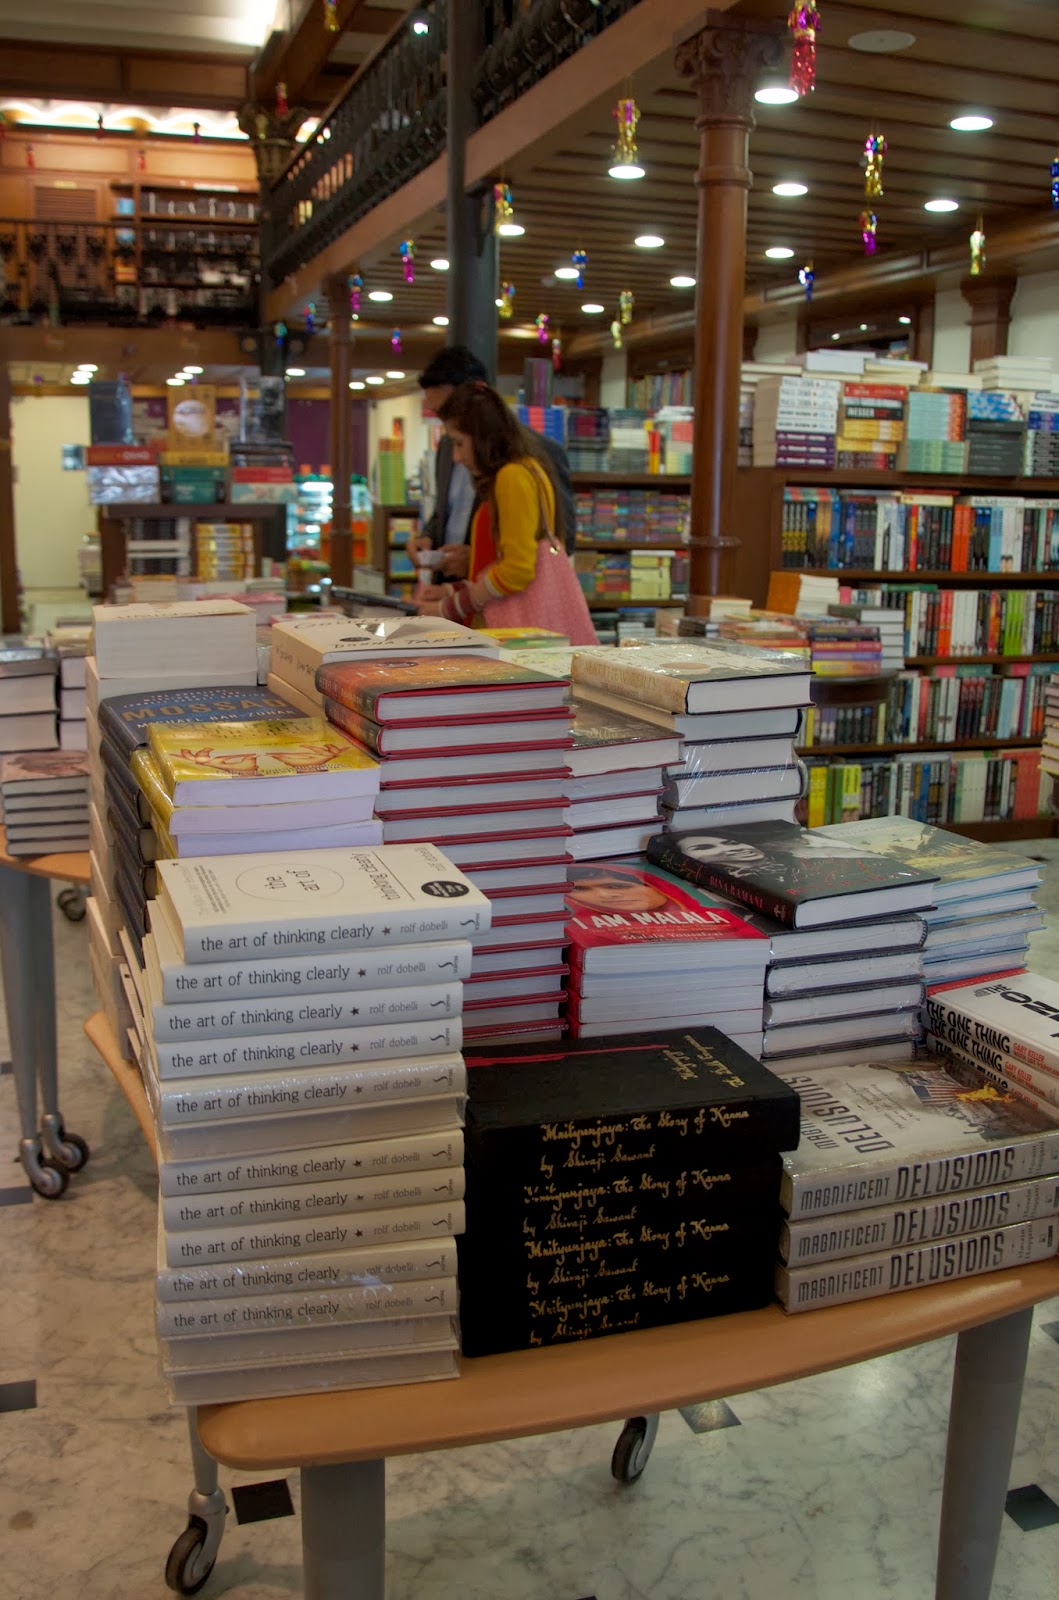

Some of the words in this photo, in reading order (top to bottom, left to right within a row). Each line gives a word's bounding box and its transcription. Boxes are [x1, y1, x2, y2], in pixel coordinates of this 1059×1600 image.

[121, 699, 288, 722] MOSSAD
[201, 937, 223, 951] the
[228, 935, 248, 949] art
[253, 932, 268, 947] of
[273, 929, 325, 945] thinking
[330, 923, 374, 940] clearly
[400, 923, 417, 934] rolf
[419, 920, 448, 931] dobelli
[572, 917, 588, 930] I
[591, 914, 631, 928] AM
[631, 911, 730, 926] MALALA
[176, 976, 198, 990] the
[203, 974, 223, 988] art
[228, 971, 243, 986] of
[249, 969, 301, 985] thinking
[306, 964, 350, 981] clearly
[377, 964, 394, 975] rolf
[396, 962, 426, 974] dobelli
[169, 1016, 191, 1030] the
[197, 1015, 216, 1028] art
[221, 1011, 236, 1026] of
[241, 1008, 294, 1024] thinking
[299, 1003, 343, 1020] clearly
[369, 1003, 386, 1014] rolf
[389, 1001, 418, 1013] dobelli
[927, 999, 945, 1022] THE
[947, 1011, 971, 1036] ONE
[974, 1022, 1010, 1054] THING
[171, 1054, 194, 1068] the
[199, 1053, 218, 1066] art
[223, 1049, 238, 1063] of
[243, 1045, 295, 1061] thinking
[300, 1039, 344, 1056] clearly
[370, 1038, 386, 1050] rolf
[389, 1035, 418, 1048] dobelli
[930, 1018, 946, 1039] THE
[948, 1027, 969, 1053] ONE
[971, 1039, 1003, 1072] THING
[176, 1099, 198, 1113] the
[203, 1098, 222, 1110] art
[227, 1093, 243, 1108] of
[248, 1090, 299, 1106] thinking
[304, 1083, 347, 1099] clearly
[373, 1081, 390, 1092] rolf
[393, 1078, 422, 1089] dobelli
[630, 1114, 652, 1130] The
[657, 1110, 688, 1136] Story
[694, 1108, 705, 1134] of
[176, 1173, 198, 1186] the
[203, 1171, 222, 1183] art
[227, 1167, 242, 1181] of
[247, 1163, 299, 1179] thinking
[303, 1157, 346, 1173] clearly
[372, 1156, 389, 1166] rolf
[391, 1152, 420, 1164] dobelli
[540, 1154, 553, 1179] by
[562, 1150, 607, 1173] Shivaji
[610, 1143, 656, 1162] Sawant
[612, 1176, 634, 1194] The
[639, 1172, 671, 1199] Story
[675, 1171, 688, 1197] of
[800, 1177, 890, 1211] MAGNIFICENT
[895, 1147, 1015, 1201] DELUSIONS
[180, 1207, 201, 1221] the
[206, 1206, 225, 1218] art
[230, 1202, 244, 1216] of
[249, 1198, 301, 1214] thinking
[305, 1192, 348, 1208] clearly
[374, 1190, 390, 1200] rolf
[393, 1187, 422, 1198] dobelli
[522, 1217, 536, 1238] by
[545, 1212, 588, 1233] Shivaji
[613, 1229, 634, 1246] The
[640, 1225, 670, 1250] Story
[675, 1222, 687, 1247] of
[798, 1222, 887, 1257] MAGNIFICENT
[891, 1191, 1010, 1246] DELUSIONS
[181, 1244, 202, 1257] the
[207, 1242, 225, 1254] art
[231, 1237, 245, 1251] of
[250, 1234, 301, 1249] thinking
[305, 1227, 348, 1243] clearly
[373, 1225, 390, 1235] rolf
[392, 1222, 421, 1233] dobelli
[173, 1279, 194, 1292] the
[200, 1278, 218, 1290] art
[223, 1275, 236, 1287] of
[242, 1271, 293, 1287] thinking
[298, 1266, 340, 1282] clearly
[366, 1266, 382, 1275] rolf
[385, 1262, 414, 1274] dobelli
[797, 1266, 884, 1303] MAGNIFICENT
[889, 1231, 1005, 1290] DELUSIONS
[526, 1272, 540, 1296] by
[616, 1285, 636, 1301] The
[642, 1280, 671, 1303] Story
[677, 1275, 688, 1300] of
[174, 1314, 195, 1327] the
[200, 1313, 218, 1325] art
[224, 1309, 237, 1322] of
[243, 1307, 293, 1322] thinking
[297, 1301, 339, 1317] clearly
[366, 1300, 381, 1310] rolf
[384, 1297, 413, 1309] dobelli
